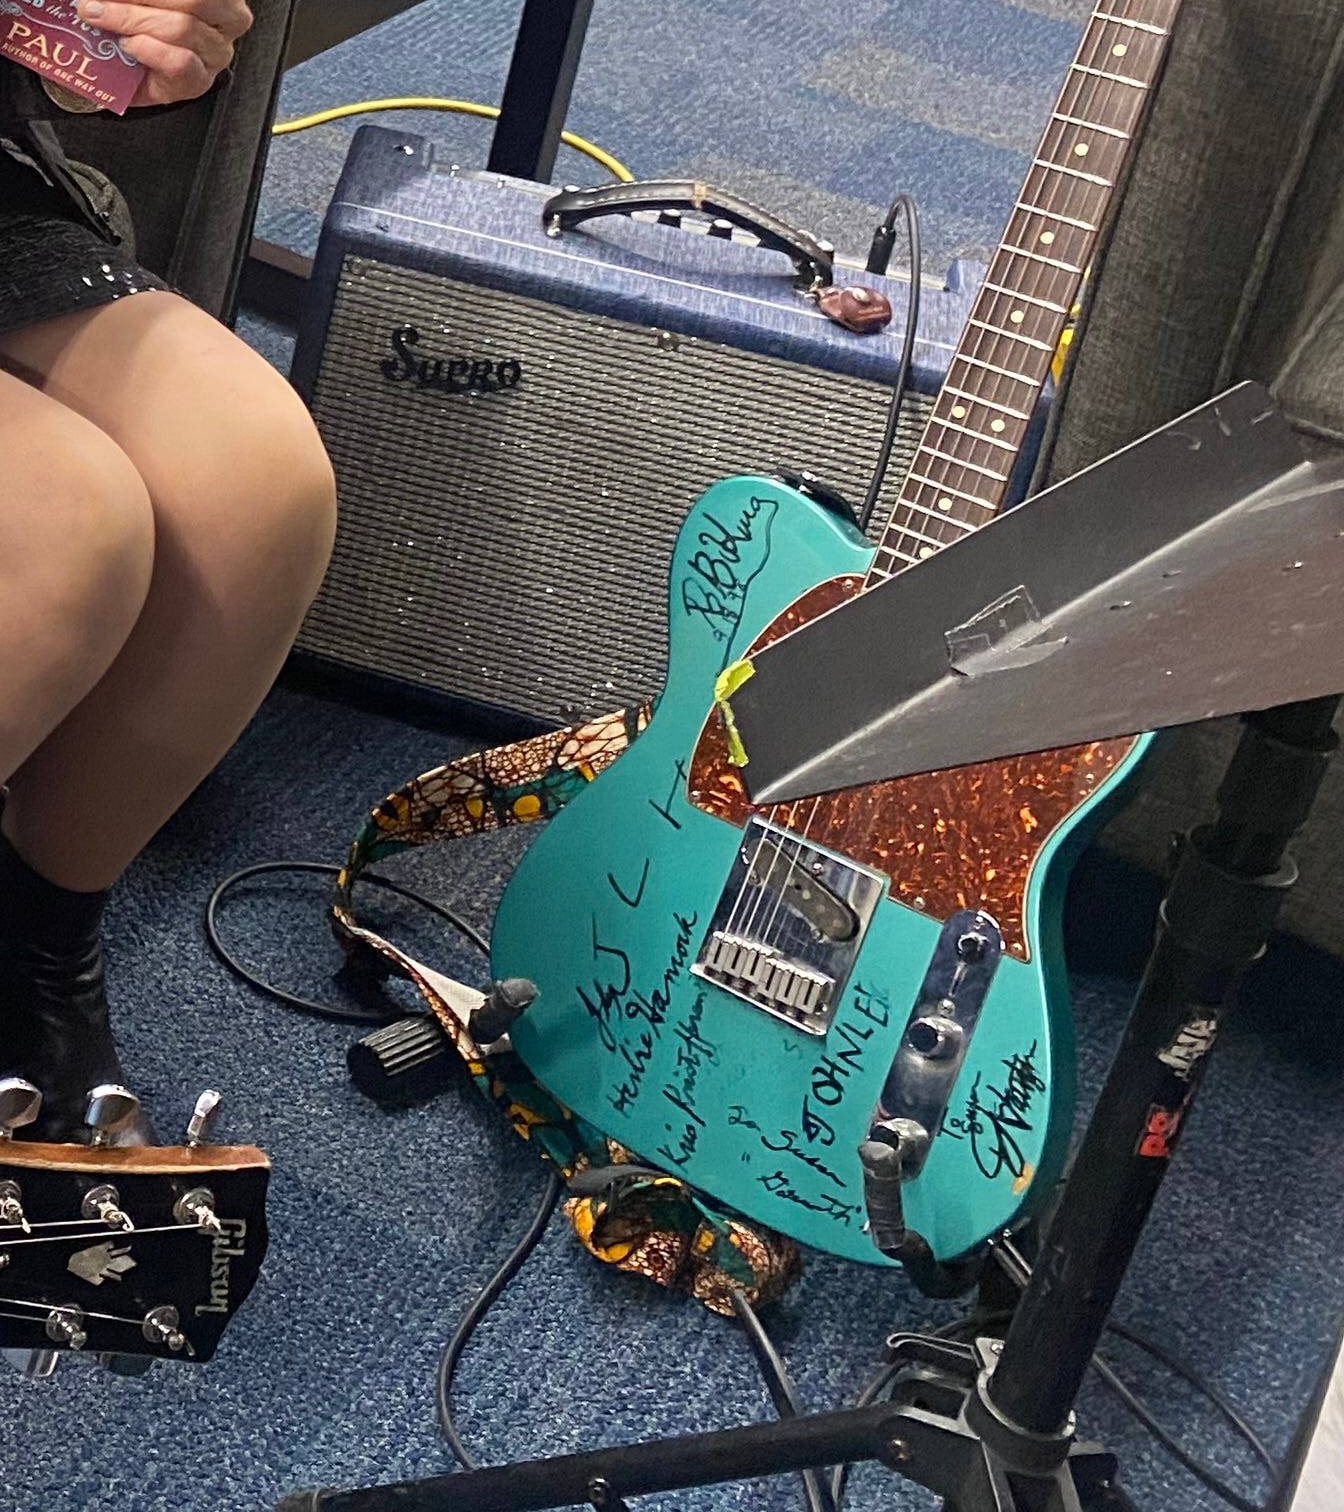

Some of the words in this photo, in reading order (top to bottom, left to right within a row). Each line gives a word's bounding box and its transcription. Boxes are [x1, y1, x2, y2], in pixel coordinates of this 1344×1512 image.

[46, 4, 68, 20] the
[2, 41, 39, 65] AUTHOR
[39, 60, 53, 71] OF
[54, 68, 75, 83] ONE
[74, 77, 96, 93] WAY
[94, 88, 117, 104] OUT
[6, 21, 99, 81] PAUL
[195, 1218, 248, 1317] Gibson
